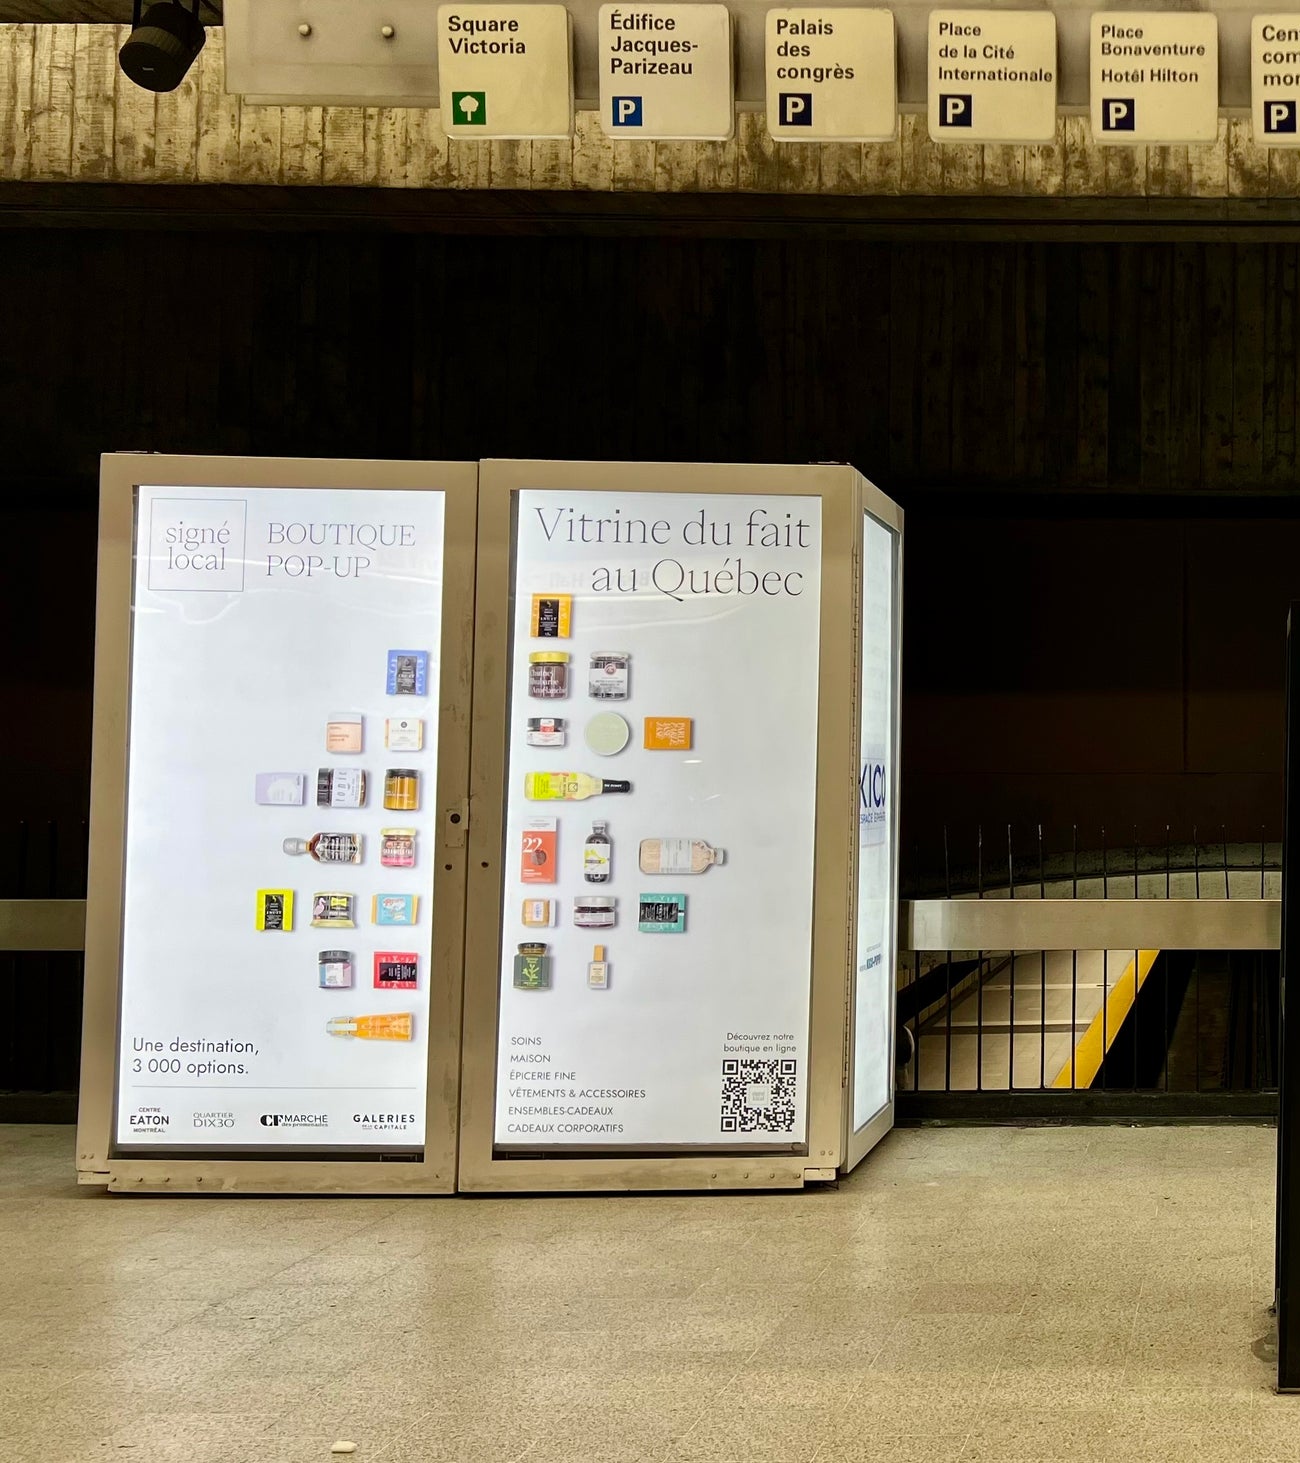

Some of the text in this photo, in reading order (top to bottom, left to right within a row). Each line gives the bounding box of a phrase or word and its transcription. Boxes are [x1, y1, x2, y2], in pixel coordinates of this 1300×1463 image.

[448, 15, 519, 35] Square
[610, 12, 676, 32] Édifice
[776, 19, 834, 37] Palais
[939, 21, 982, 36] Place
[1101, 24, 1144, 39] Place
[448, 37, 527, 56] Victoria
[610, 35, 699, 56] Jacques-
[776, 41, 811, 58] des
[938, 44, 1015, 60] de la Cité
[1101, 41, 1206, 57] Bonaventure
[610, 57, 693, 76] Parizeau
[776, 62, 855, 83] congrès
[938, 65, 1053, 83] Internationale
[1150, 68, 1199, 83] Hilton
[618, 99, 636, 121] P
[786, 97, 805, 121] P
[946, 97, 965, 124] P
[1109, 101, 1128, 129] P
[1270, 103, 1289, 131] P
[165, 520, 231, 552] signé
[267, 522, 416, 552] BOUTIQUE
[532, 507, 811, 549] Vitrine du fait
[167, 546, 226, 572] local
[266, 554, 372, 579] POP-UP
[591, 557, 804, 602] au Québec
[522, 837, 543, 853] 22
[510, 1036, 542, 1046] SOINS
[726, 1032, 795, 1042] Découvrez notre
[132, 1037, 261, 1056] Une destination,
[723, 1044, 797, 1055] boutique en ligne
[510, 1053, 552, 1063] MAISON
[132, 1058, 250, 1078] 3 000 options.
[509, 1069, 577, 1082] ÉPICERIE FINE
[508, 1086, 646, 1099] VÊTEMENTS & ACCESSOIRES
[352, 1114, 415, 1123] GALERIES
[508, 1105, 614, 1116] ENSEMBLES-CADEAUX
[129, 1115, 170, 1125] EATON
[260, 1114, 284, 1127] CF
[507, 1123, 625, 1134] CADEAUX CORPORATIFS
